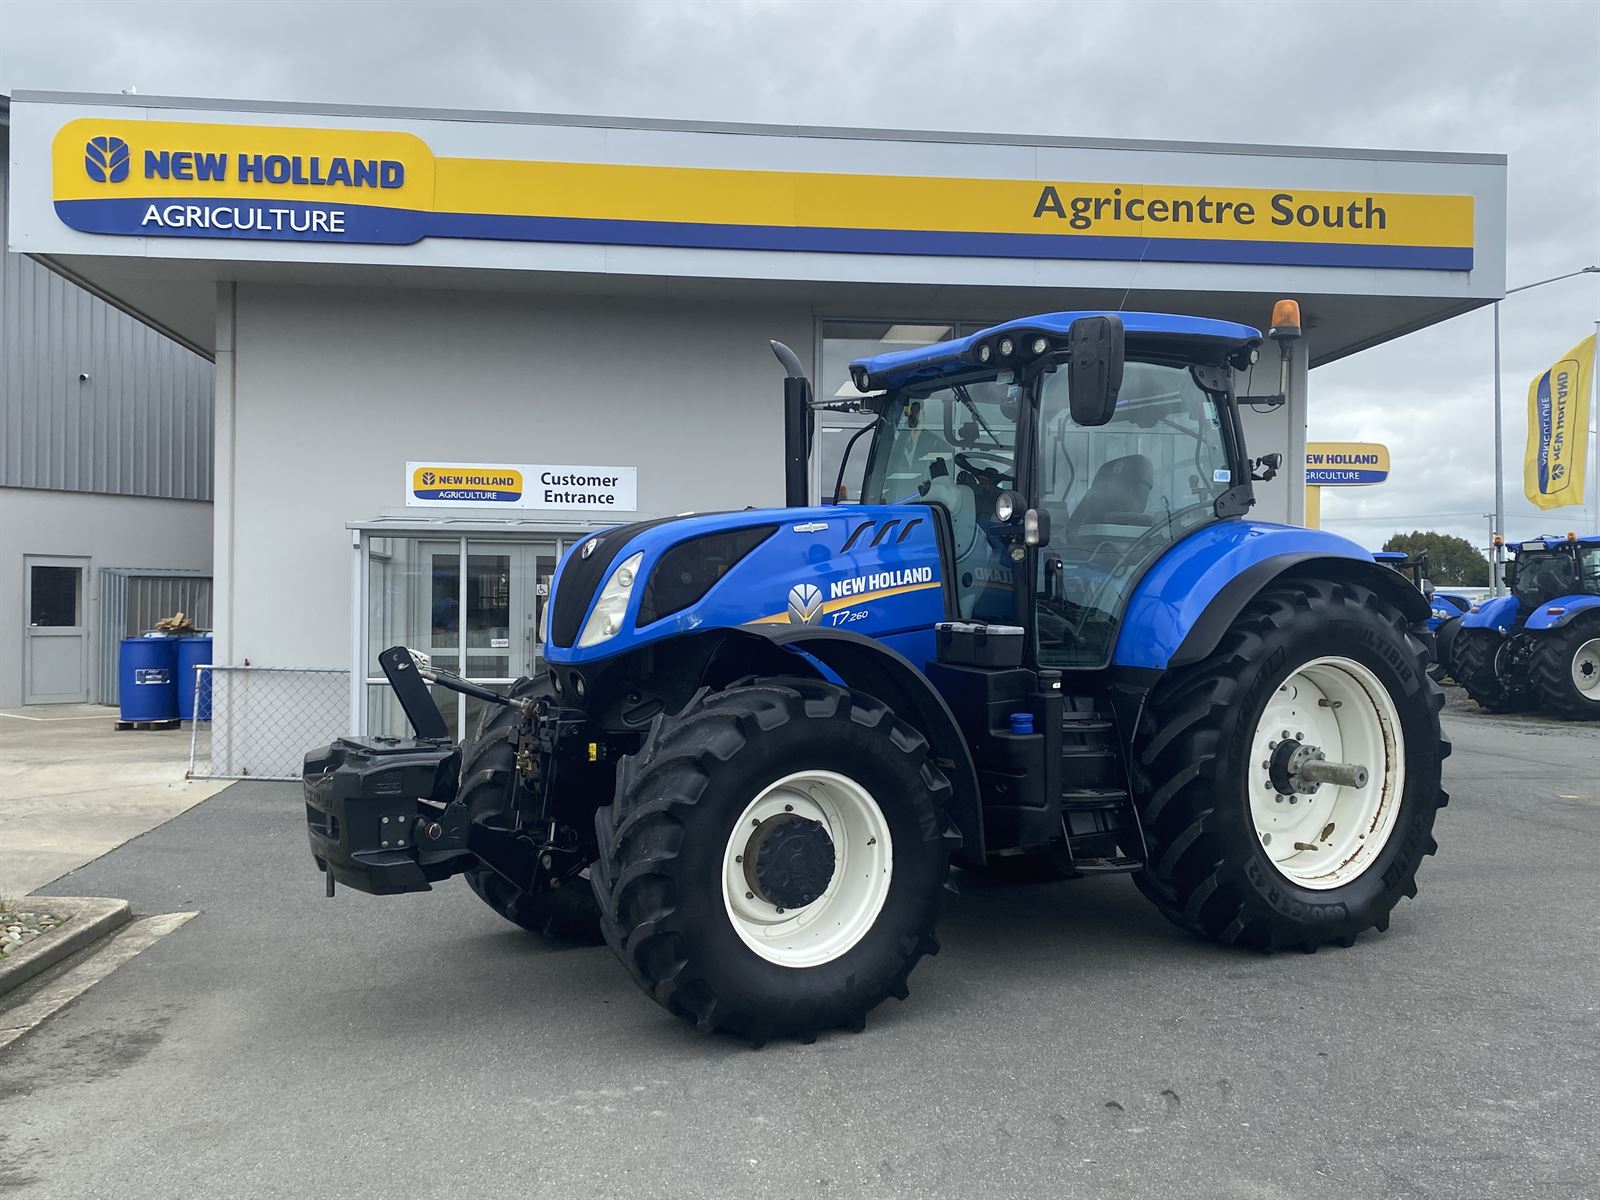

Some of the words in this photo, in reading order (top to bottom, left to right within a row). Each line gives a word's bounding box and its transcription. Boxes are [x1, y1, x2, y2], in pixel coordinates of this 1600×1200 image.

[144, 149, 228, 182] NEW
[238, 153, 405, 189] HOLLAND
[1032, 185, 1256, 230] Agricentre
[1270, 193, 1387, 230] South
[141, 204, 346, 233] AGRICULTURE
[1306, 454, 1324, 464] EW
[1326, 454, 1378, 464] HOLLAND
[439, 475, 463, 485] NEW
[465, 476, 514, 486] HOLLAND
[540, 472, 619, 488] Customer
[1305, 471, 1360, 480] GRICULTURE
[438, 491, 497, 500] AGRICULTURE
[544, 490, 615, 505] Entrance
[830, 578, 866, 599] NEW
[869, 566, 932, 591] HOLLAND
